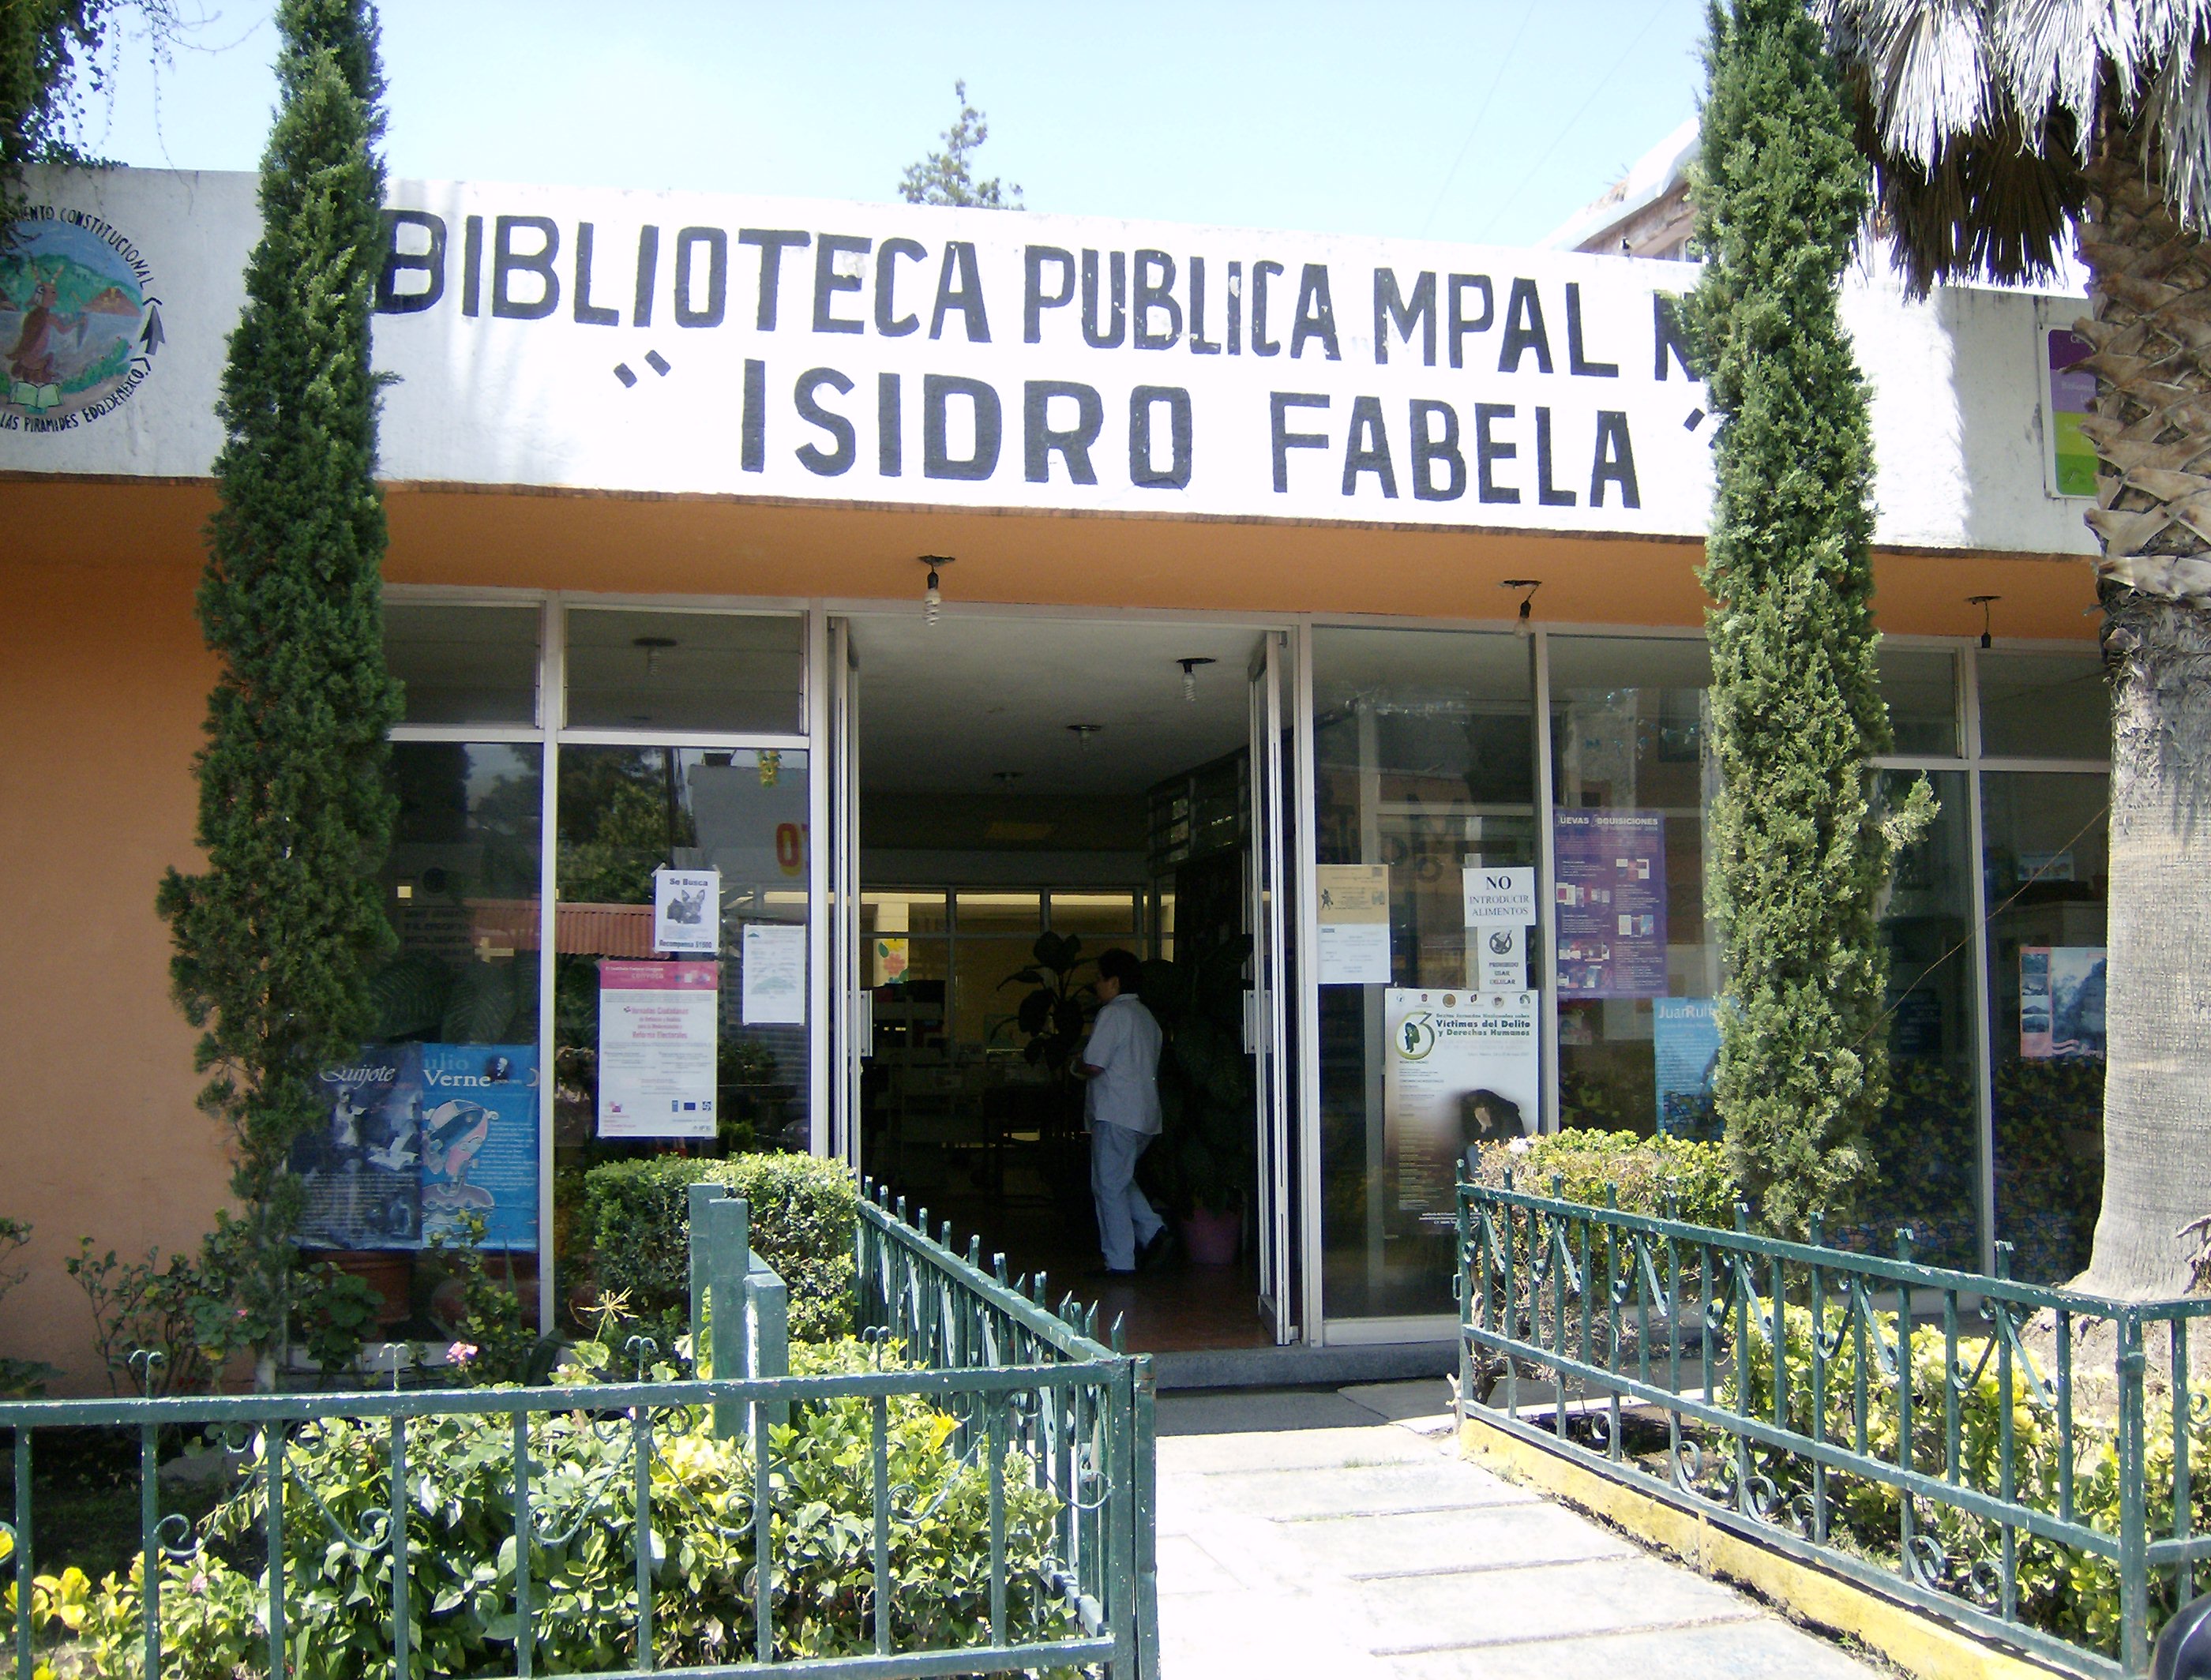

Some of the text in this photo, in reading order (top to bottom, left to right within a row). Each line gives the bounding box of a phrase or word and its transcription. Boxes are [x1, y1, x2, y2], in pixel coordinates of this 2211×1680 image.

[374, 208, 992, 343] BIBLIOTECA
[1023, 245, 1342, 361] PUBLICA
[1373, 268, 1619, 378] MPAL
[741, 358, 1641, 509] ISIDRO FABELA
[1486, 875, 1511, 891] NO
[1470, 894, 1530, 905] INTRODUCIR
[1472, 906, 1529, 917] ALIMENTOS
[1481, 1019, 1498, 1028] del
[1501, 1019, 1530, 1028] Delito
[423, 1069, 491, 1087] Verne
